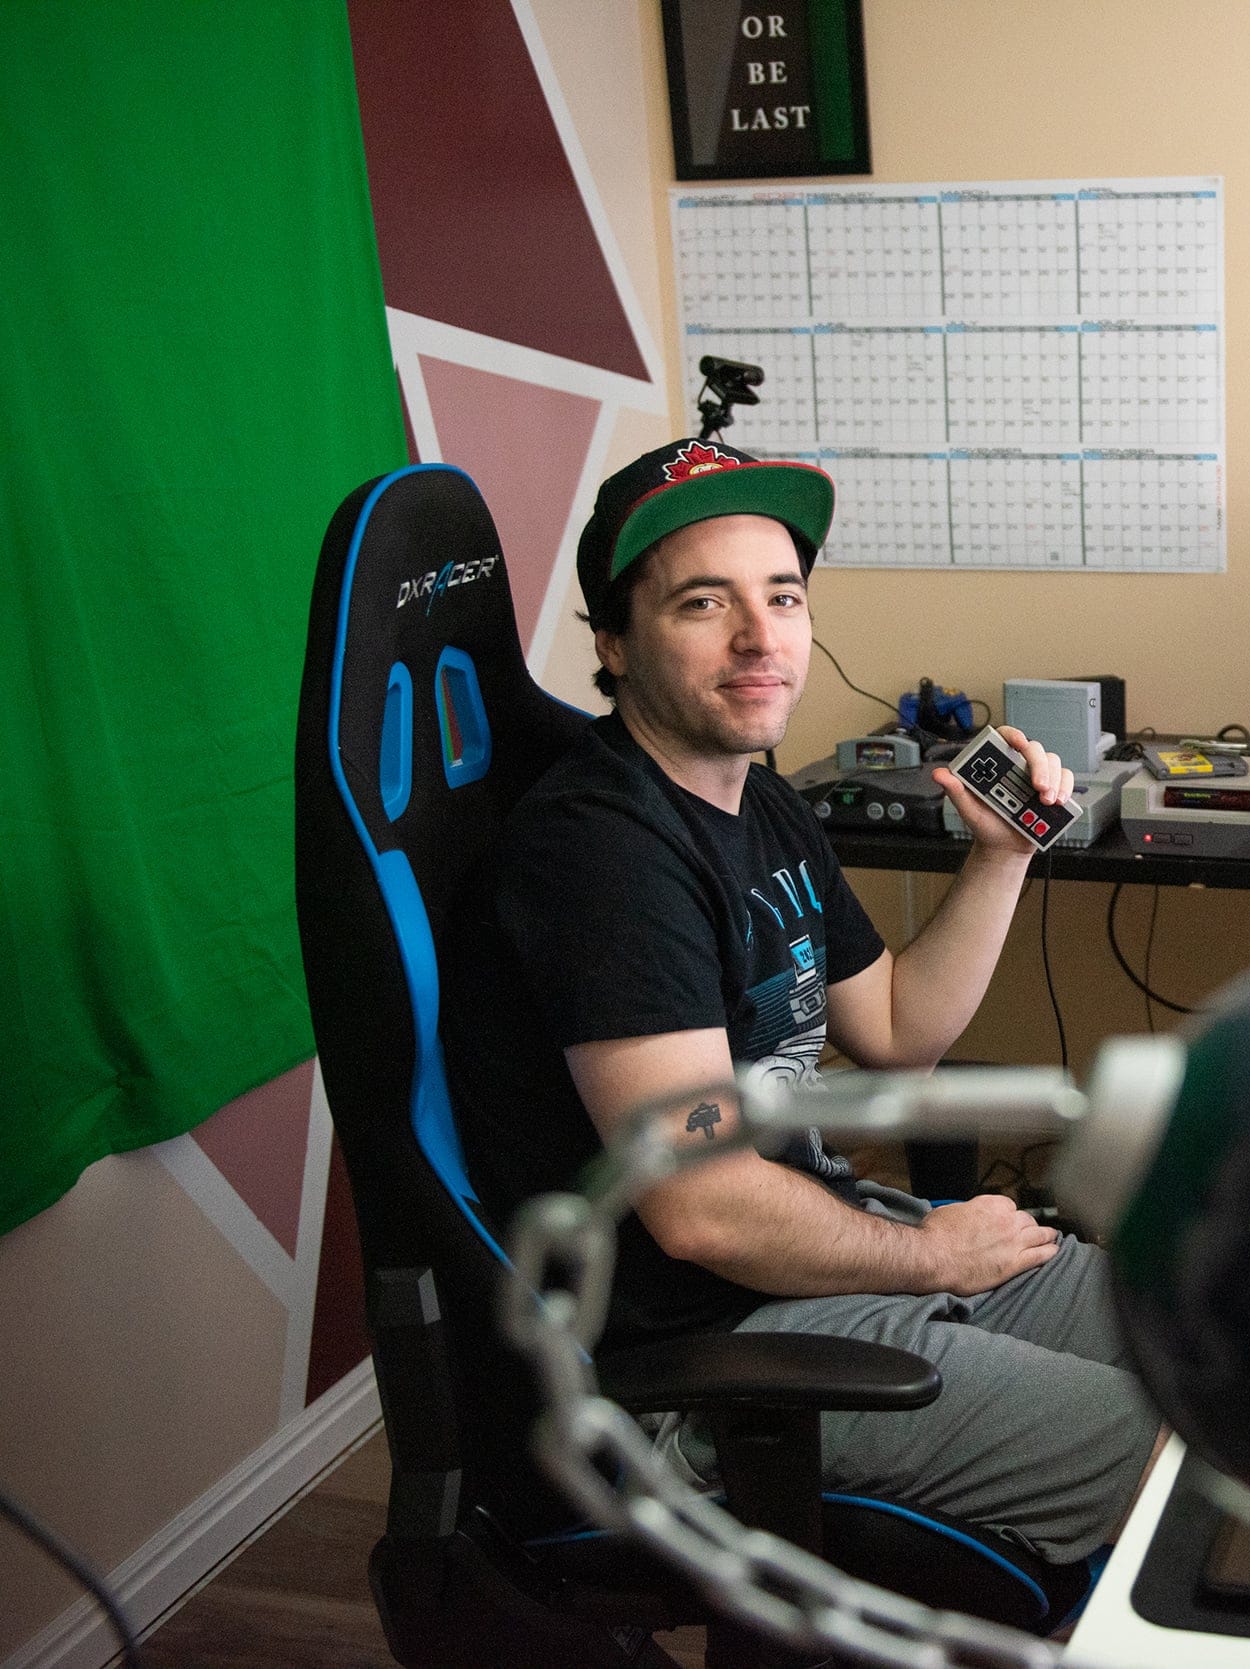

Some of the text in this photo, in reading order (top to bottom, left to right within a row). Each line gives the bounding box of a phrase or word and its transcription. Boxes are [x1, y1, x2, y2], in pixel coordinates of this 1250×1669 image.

[742, 15, 787, 39] OR
[747, 61, 788, 85] BE
[731, 106, 811, 131] LAST
[397, 557, 495, 616] DXRACER
